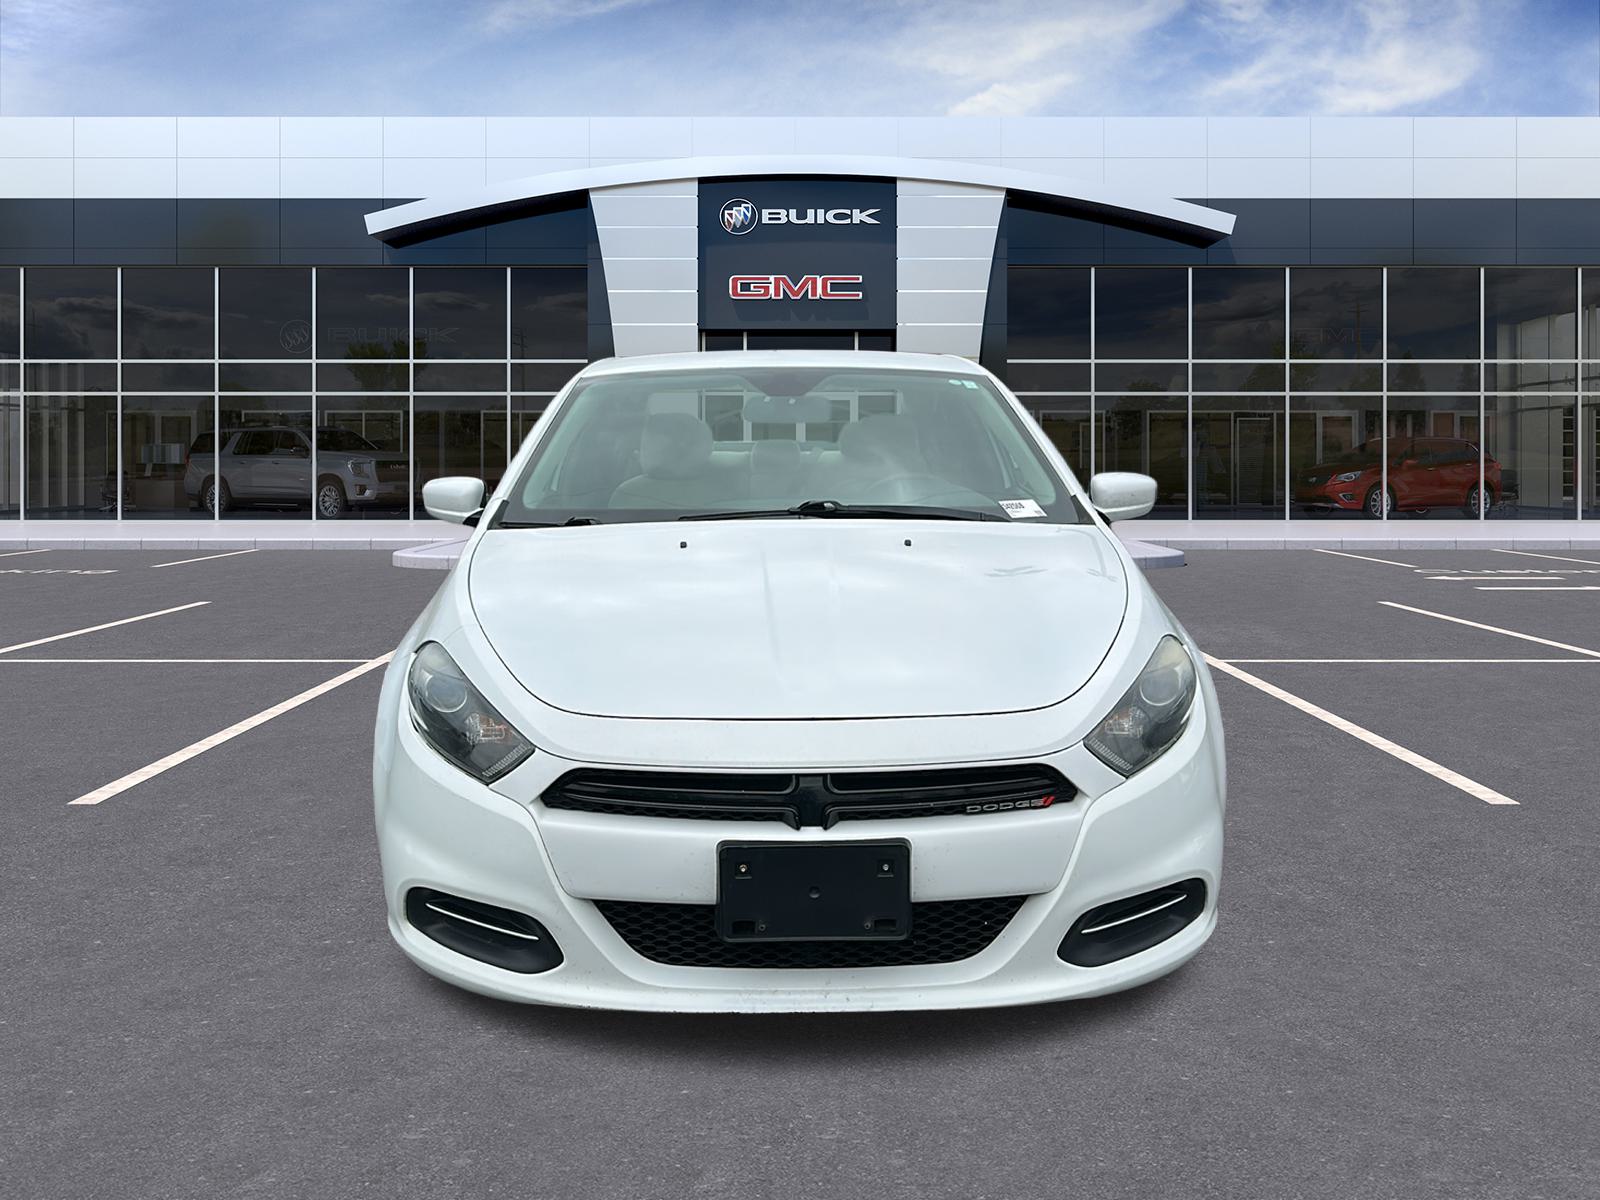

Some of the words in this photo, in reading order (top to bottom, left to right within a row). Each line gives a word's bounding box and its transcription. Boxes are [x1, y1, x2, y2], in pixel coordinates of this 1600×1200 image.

[761, 208, 881, 224] BUICK
[728, 274, 863, 300] GMC
[966, 798, 1043, 813] DODGE
